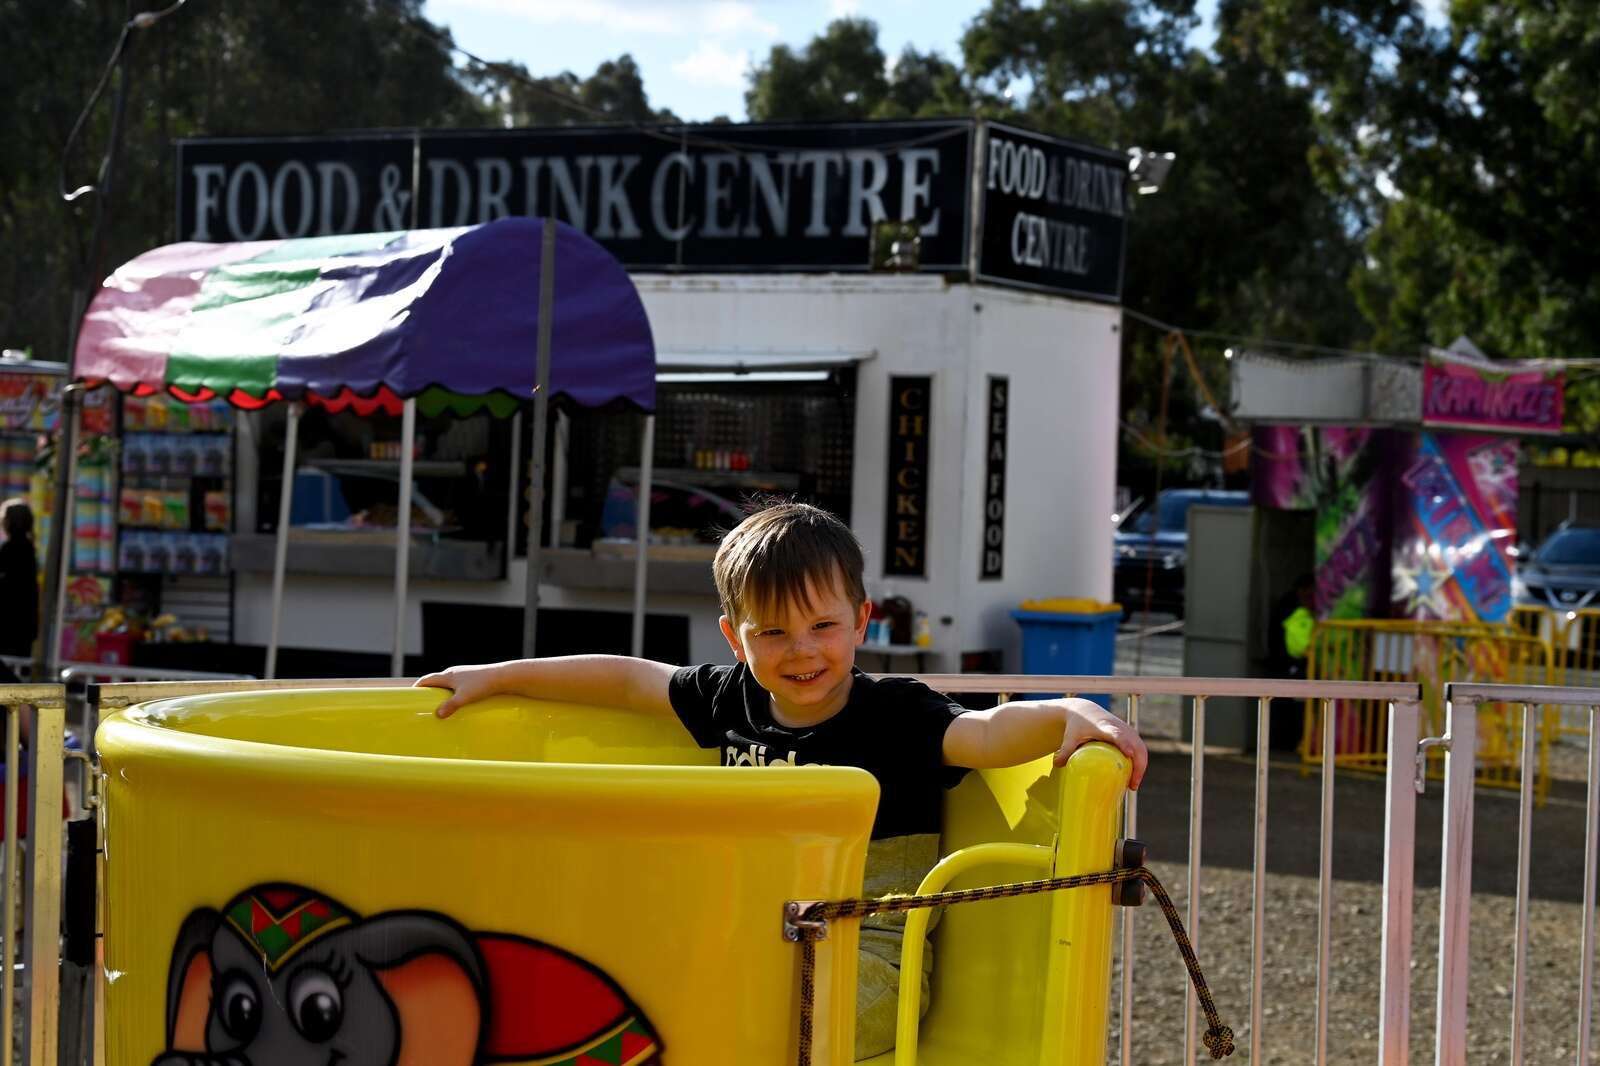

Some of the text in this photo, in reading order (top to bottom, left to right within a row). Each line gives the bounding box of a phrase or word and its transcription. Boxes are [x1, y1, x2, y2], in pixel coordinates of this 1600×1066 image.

[192, 148, 941, 241] FOOD & DRINK CENTRE
[987, 136, 1047, 200] FOOD
[1062, 156, 1125, 217] DRINK
[1011, 210, 1091, 276] CENTRE
[1427, 374, 1557, 424] KAMIKAZE
[894, 387, 924, 568] CHICKEN
